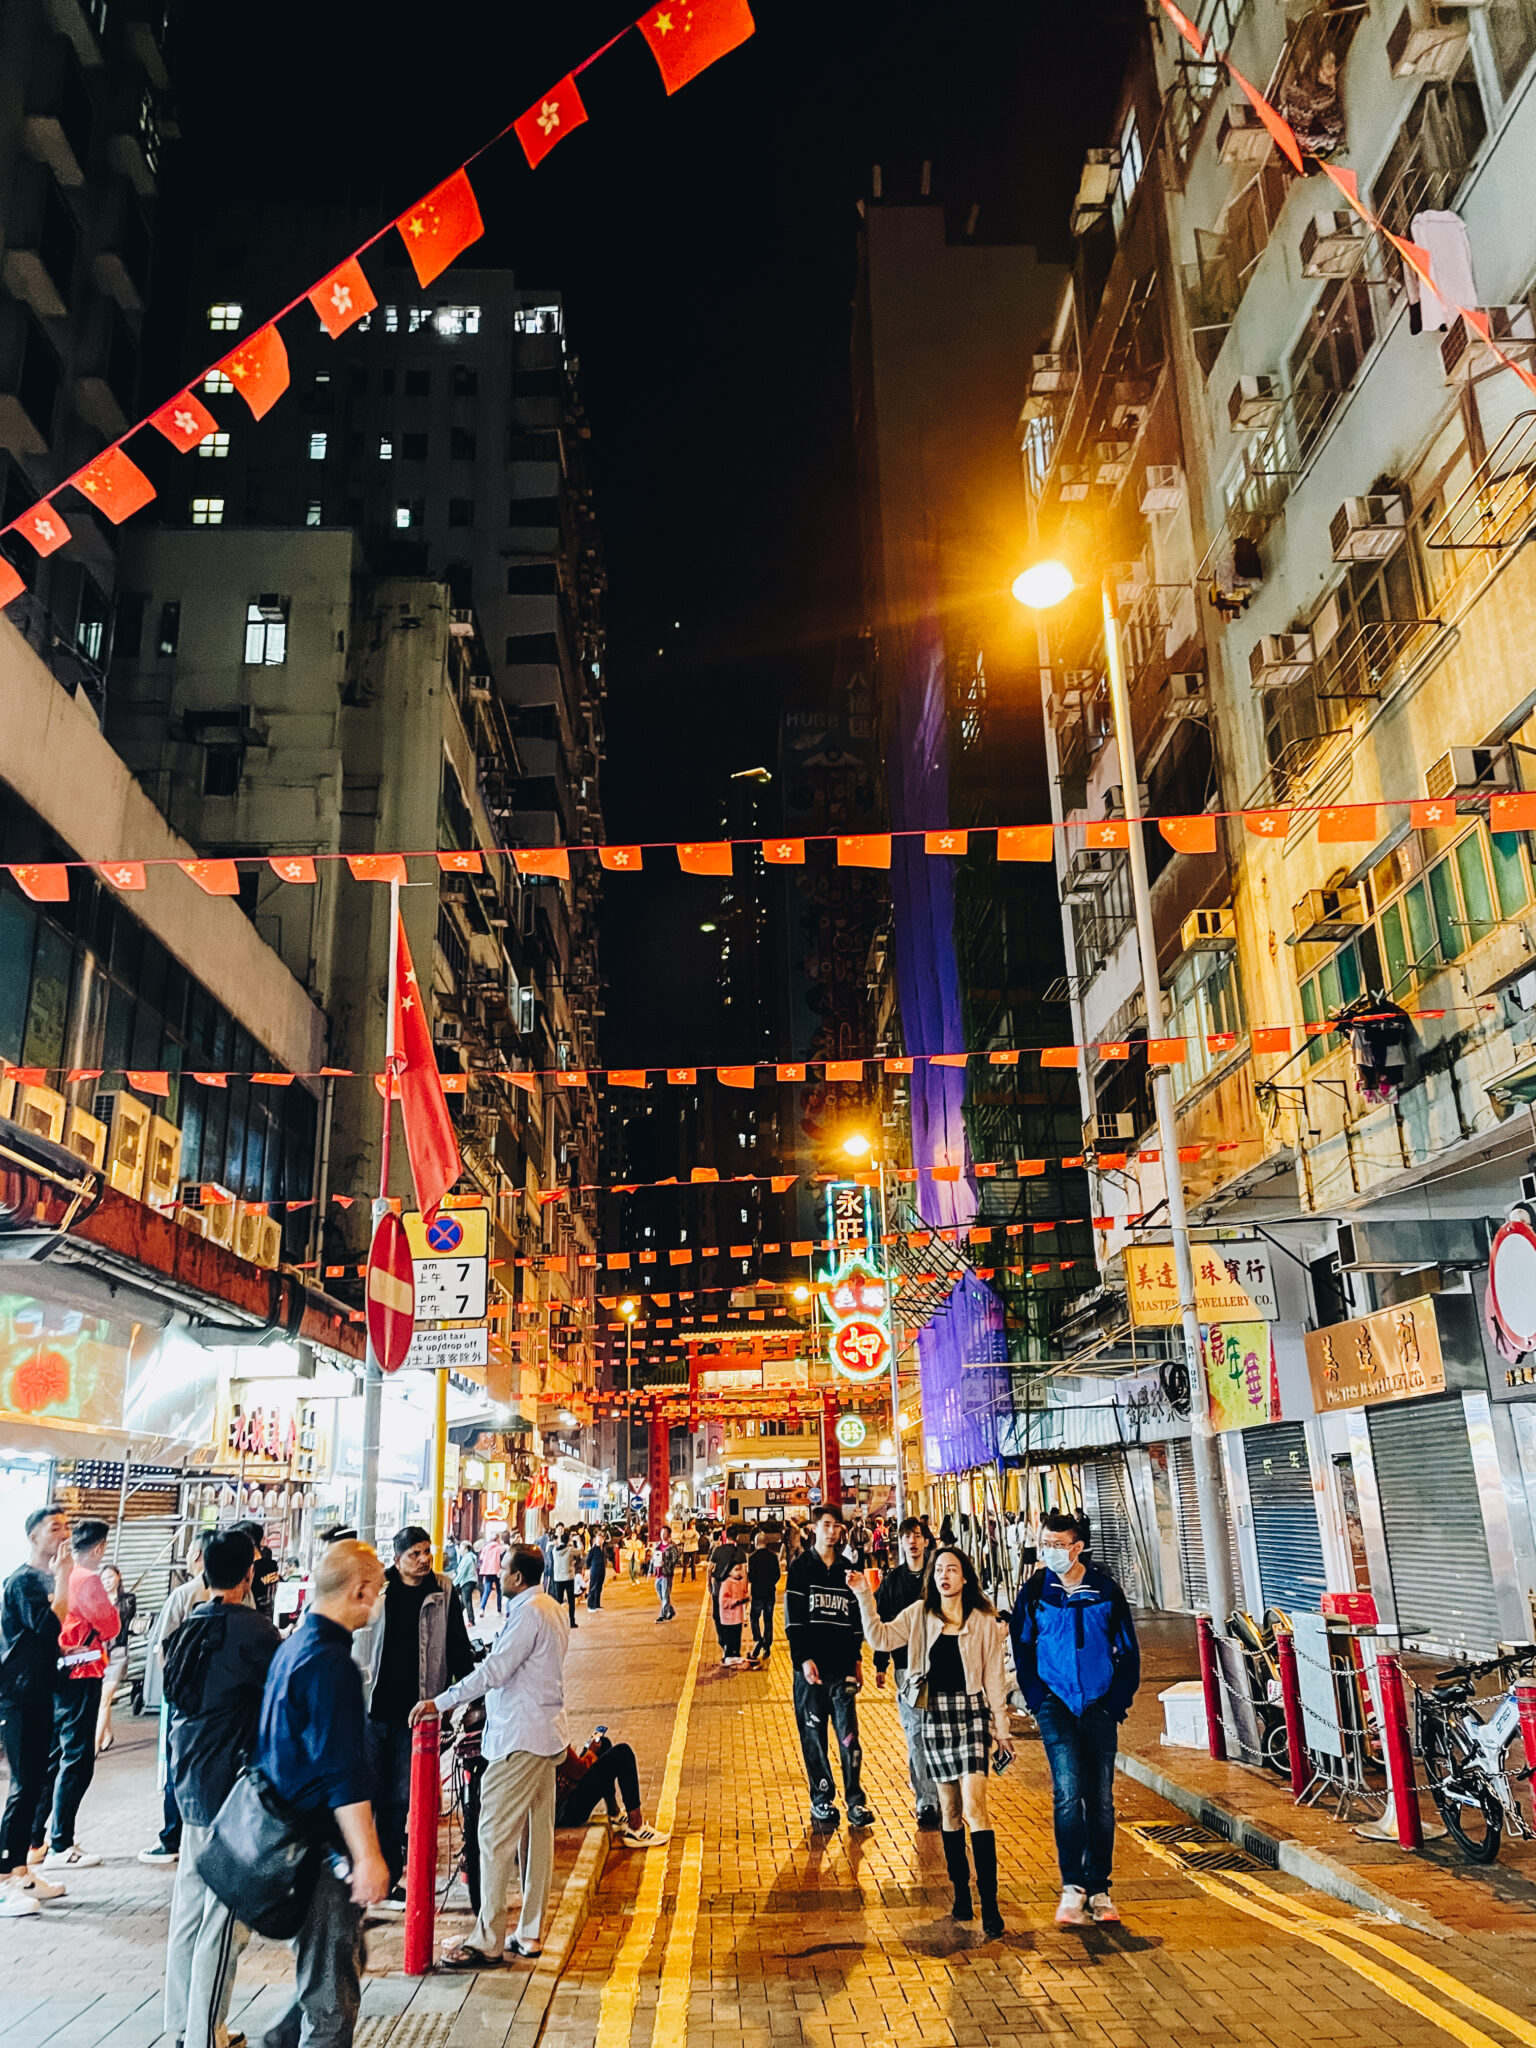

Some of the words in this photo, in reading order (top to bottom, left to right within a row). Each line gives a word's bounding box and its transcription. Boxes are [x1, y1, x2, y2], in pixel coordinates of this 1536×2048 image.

[417, 1272, 442, 1284] 上午
[457, 1263, 470, 1282] 7
[1136, 1258, 1266, 1290] 美達珠寶行
[421, 1295, 436, 1303] pm
[456, 1295, 469, 1314] 7
[1196, 1295, 1249, 1309] EWELLERY
[1255, 1294, 1273, 1305] CO.
[416, 1305, 440, 1316] 下午
[417, 1334, 446, 1342] Except
[450, 1332, 466, 1340] taxi
[411, 1344, 423, 1352] ick
[426, 1341, 462, 1352] up/drop
[464, 1341, 477, 1349] off
[844, 1326, 882, 1367] 押
